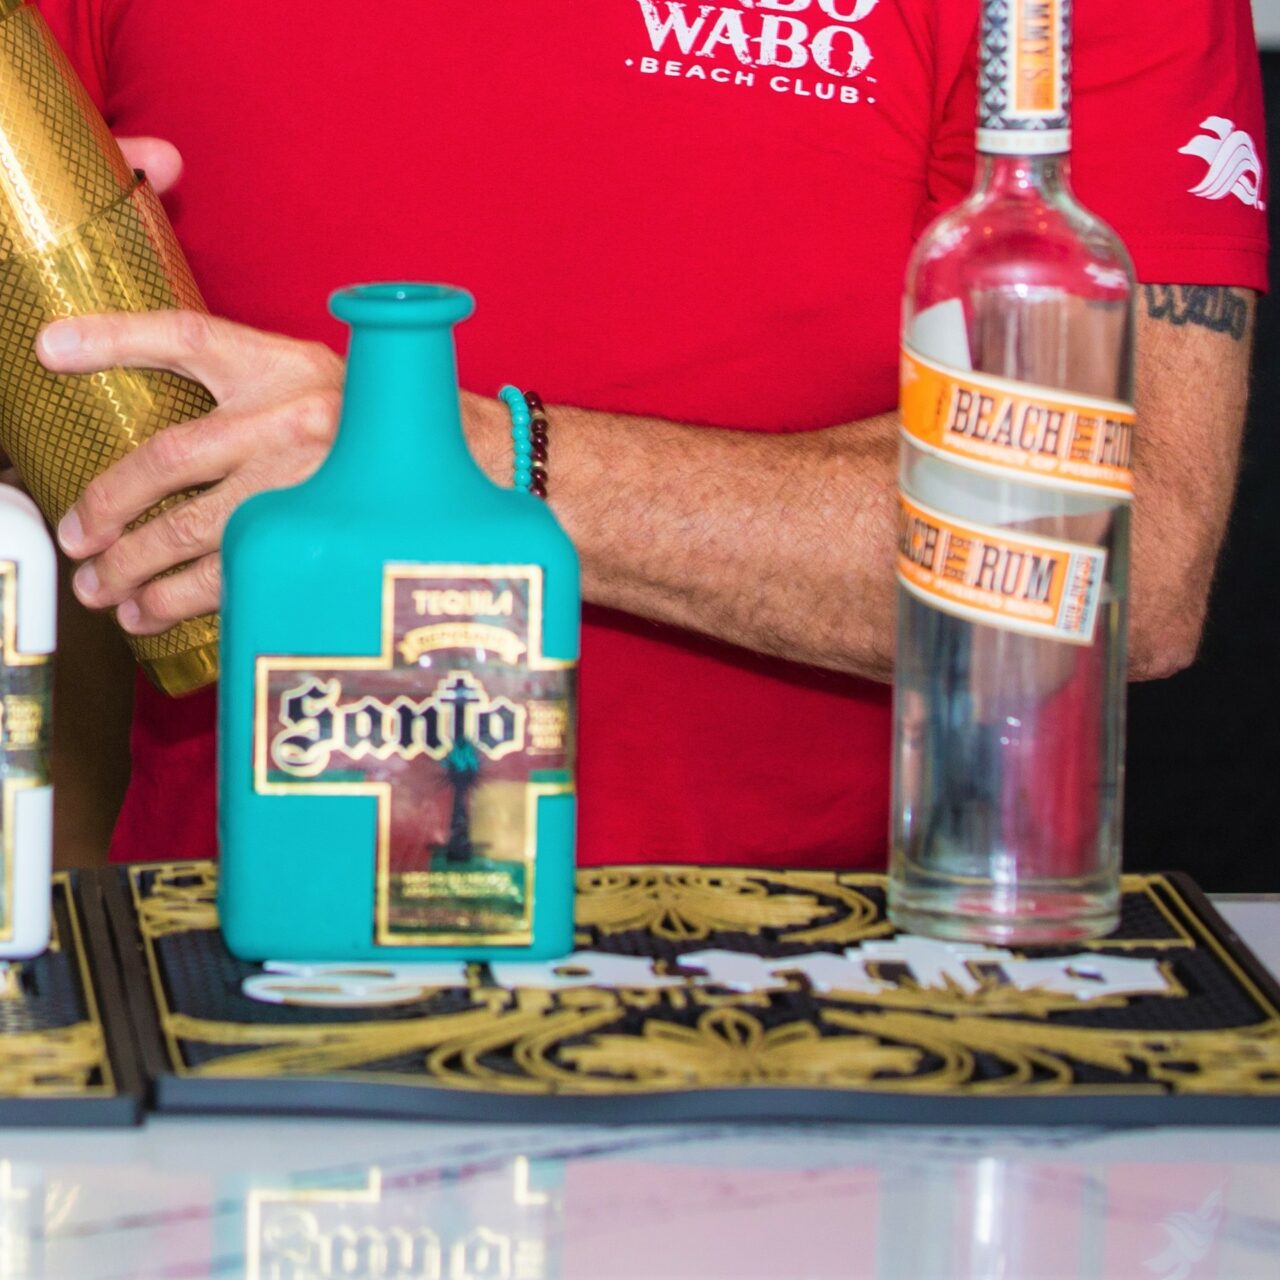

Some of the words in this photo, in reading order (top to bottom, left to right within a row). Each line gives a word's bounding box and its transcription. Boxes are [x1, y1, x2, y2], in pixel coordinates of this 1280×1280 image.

[640, 57, 754, 87] BEACH
[770, 74, 860, 104] CLUB
[950, 388, 1066, 455] BEACH
[411, 589, 513, 616] TEQUILA
[975, 544, 1057, 604] RUM
[272, 670, 524, 777] Santo
